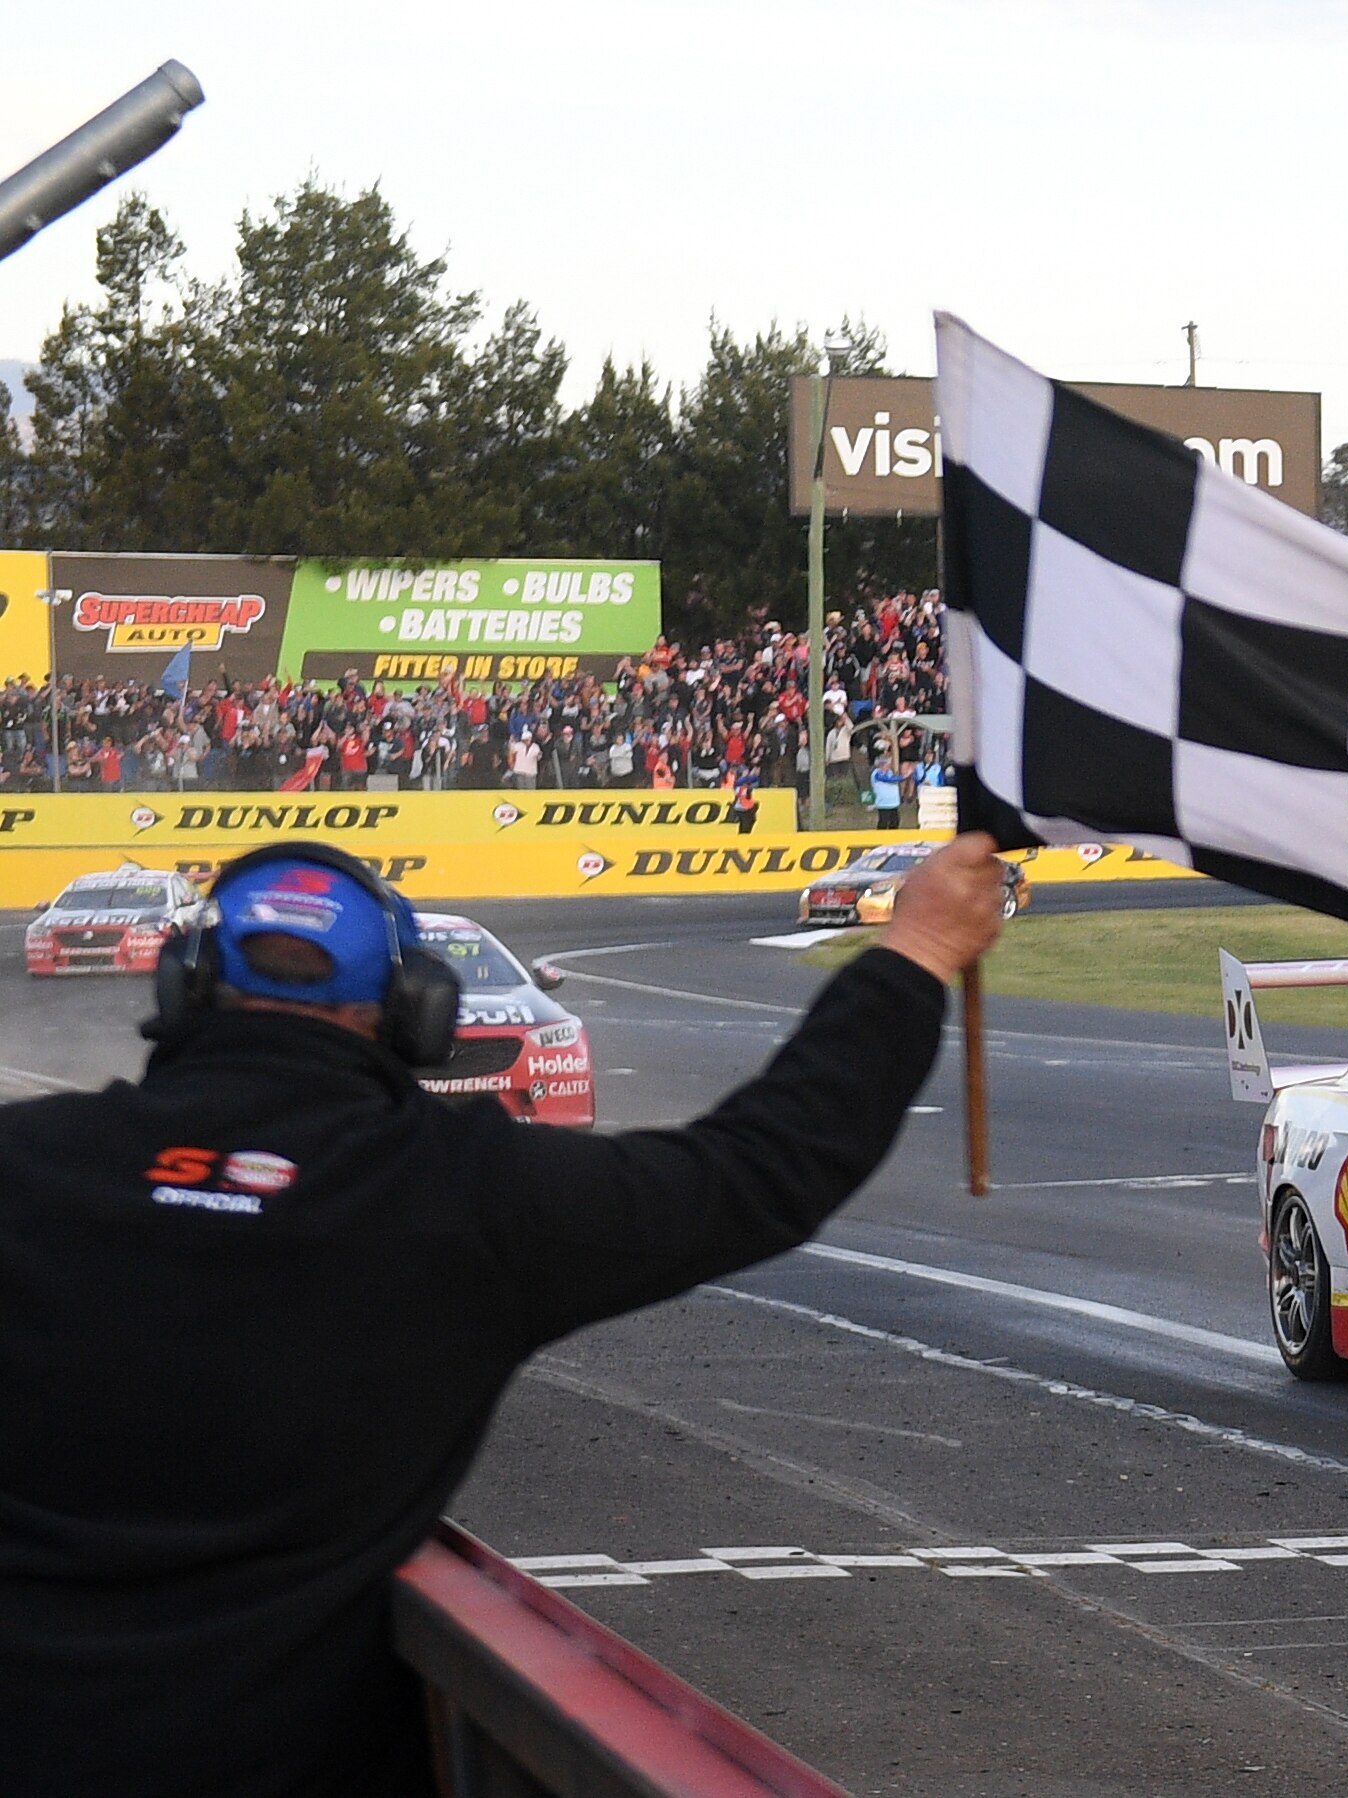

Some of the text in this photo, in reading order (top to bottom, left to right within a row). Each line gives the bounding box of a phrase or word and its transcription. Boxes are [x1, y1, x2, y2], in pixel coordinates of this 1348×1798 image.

[346, 569, 635, 605] WIPERS BULBS
[77, 596, 262, 628] SUPERCHEAP
[126, 627, 208, 642] AUTO
[398, 608, 584, 642] BATTERIES
[373, 655, 579, 680] FITTED IN STORE
[173, 805, 401, 830] DUNLOP
[447, 943, 480, 958] 97
[549, 1080, 590, 1097] CALTEX
